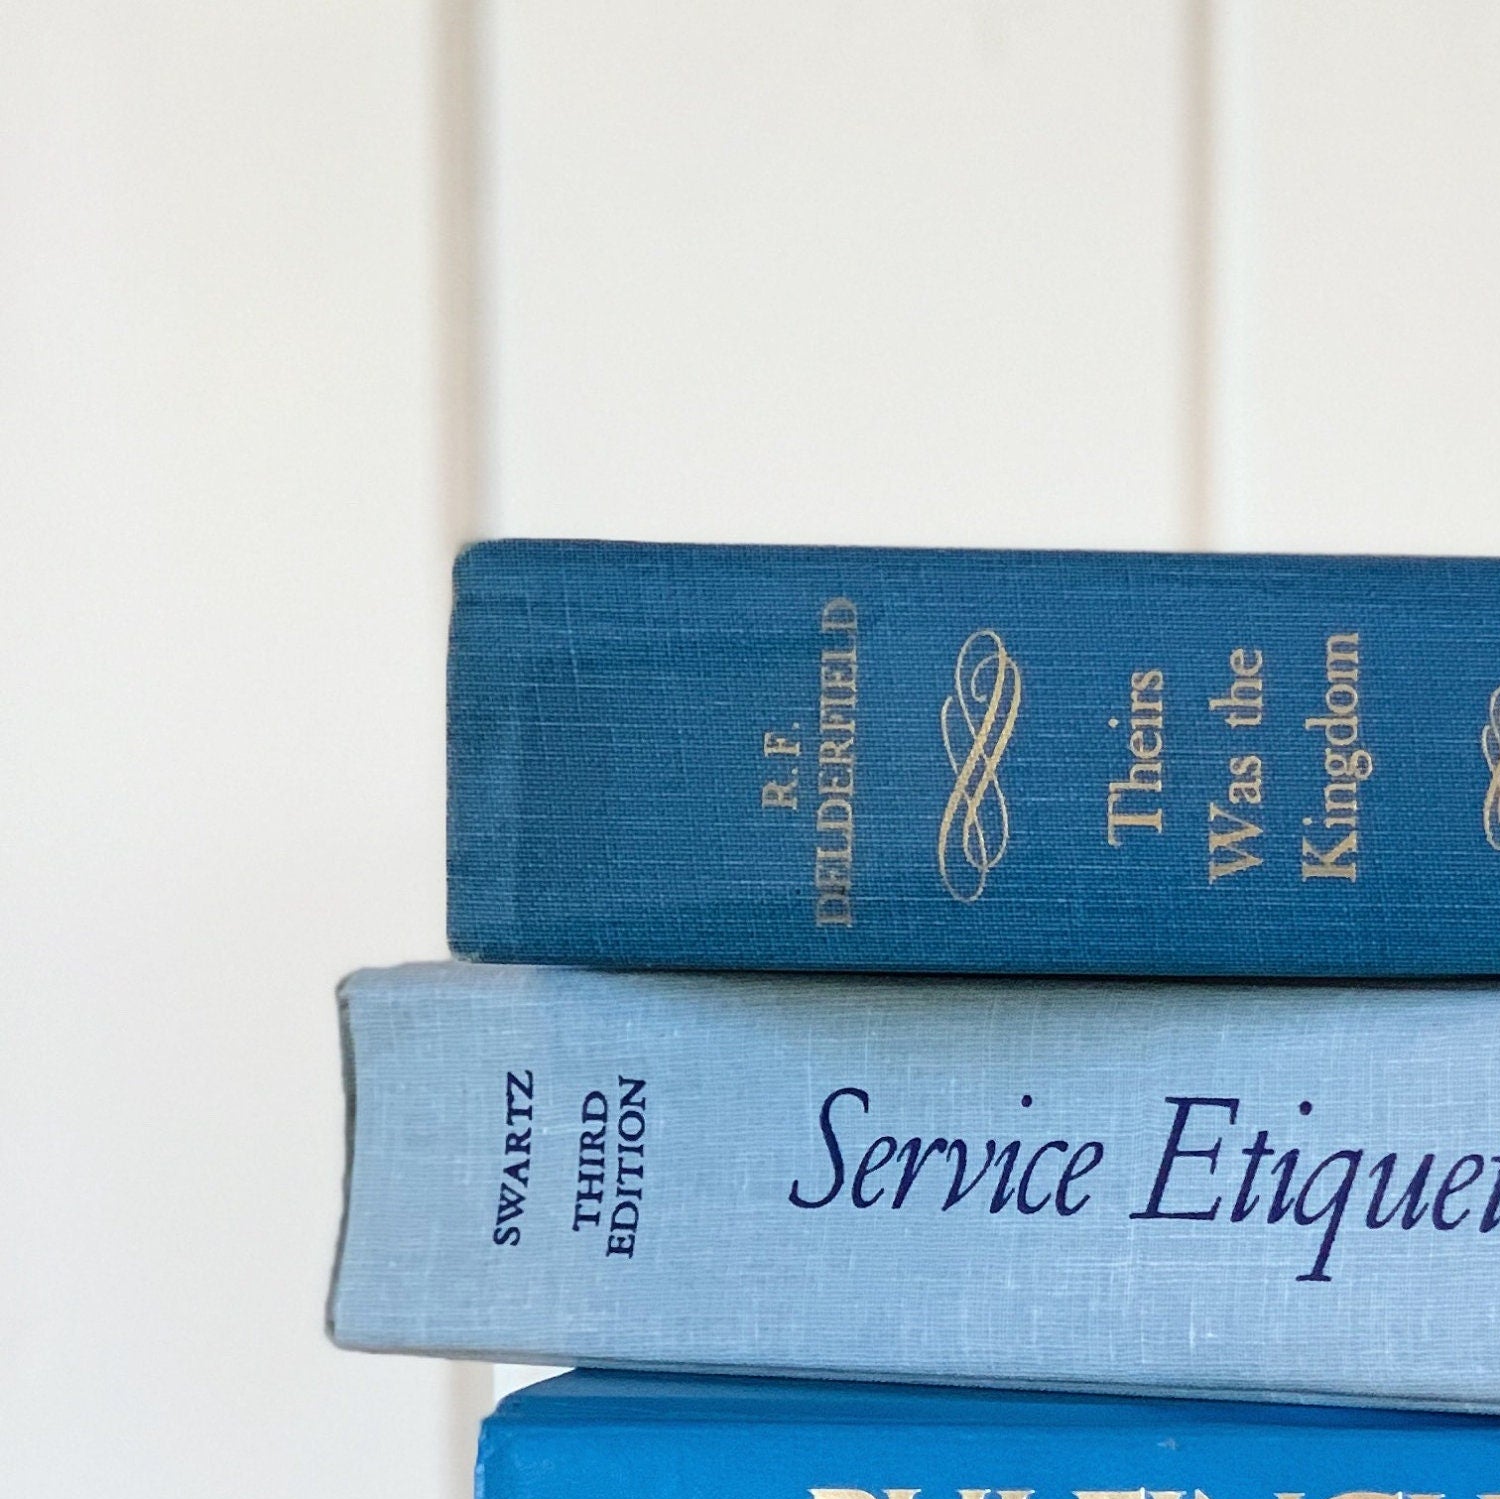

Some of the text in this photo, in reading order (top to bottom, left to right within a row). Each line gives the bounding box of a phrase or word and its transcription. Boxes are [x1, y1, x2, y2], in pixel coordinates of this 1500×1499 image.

[763, 721, 800, 811] R. F.
[815, 598, 859, 929] DELDERFIELD
[1108, 668, 1164, 848] Theirs
[1208, 647, 1264, 884] Was the
[1303, 632, 1373, 884] Kingdom
[493, 1070, 533, 1246] SWARTZ
[573, 1091, 608, 1231] THIRD
[607, 1076, 646, 1258] EDITION
[789, 1088, 1104, 1216] Service
